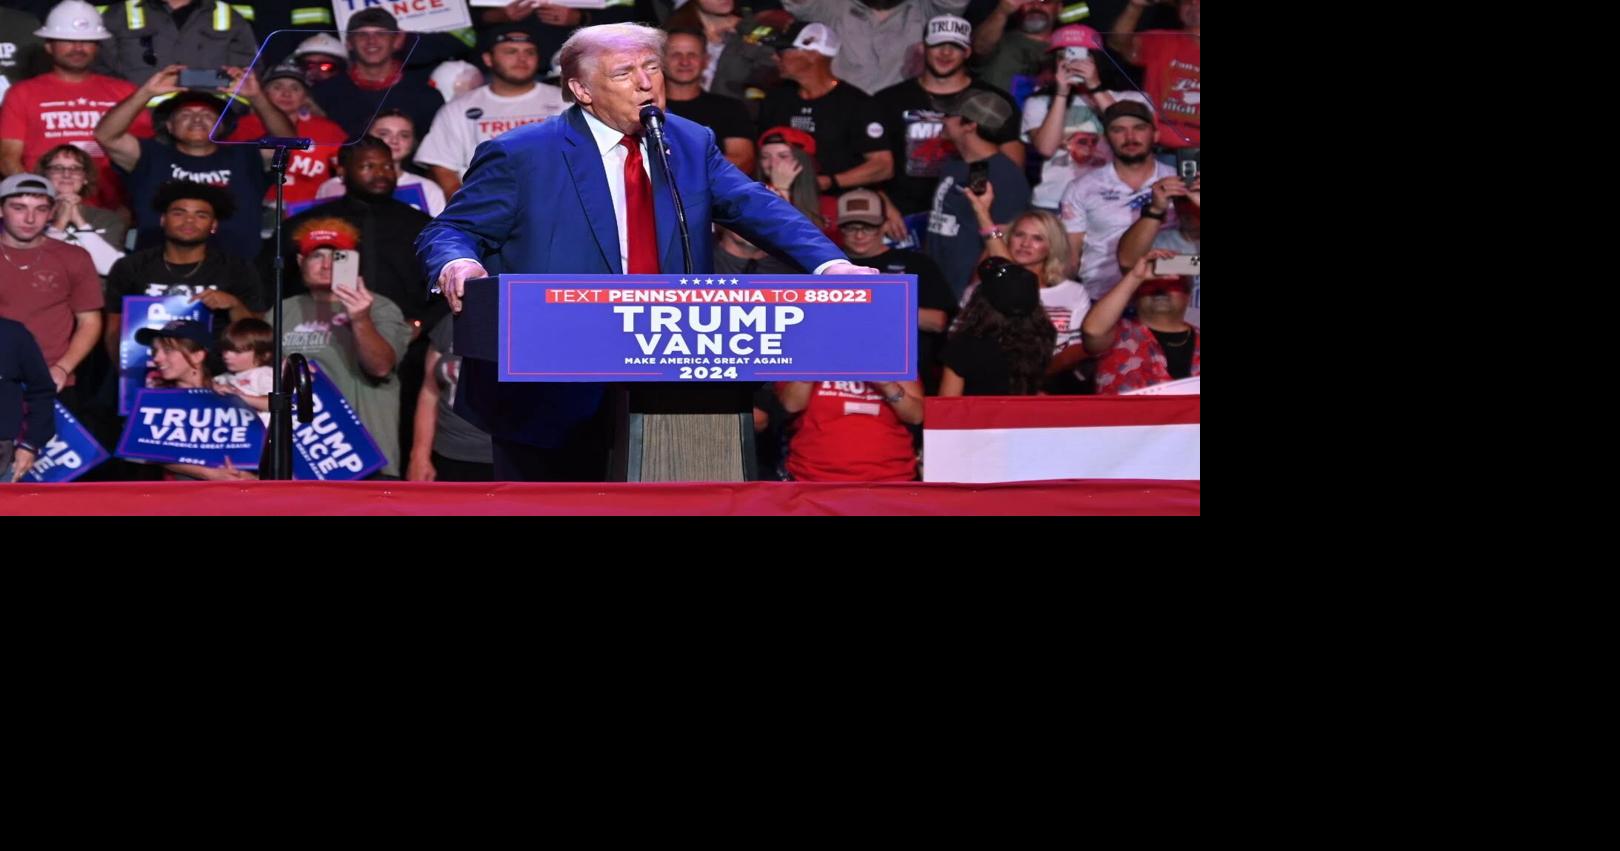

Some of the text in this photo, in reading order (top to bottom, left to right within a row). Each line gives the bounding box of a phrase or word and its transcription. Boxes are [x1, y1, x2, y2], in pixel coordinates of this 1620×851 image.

[931, 21, 970, 33] TRUMP
[41, 111, 103, 130] TRU
[551, 289, 867, 302] TEXT PENNSYLVANIA TO 88022
[613, 305, 805, 332] TRUMP
[634, 333, 782, 355] VANCE
[679, 366, 738, 379] 2024
[139, 406, 254, 427] TRUMP
[138, 437, 161, 445] MAKE
[163, 440, 198, 449] AMERICA
[150, 425, 247, 443] VANCE
